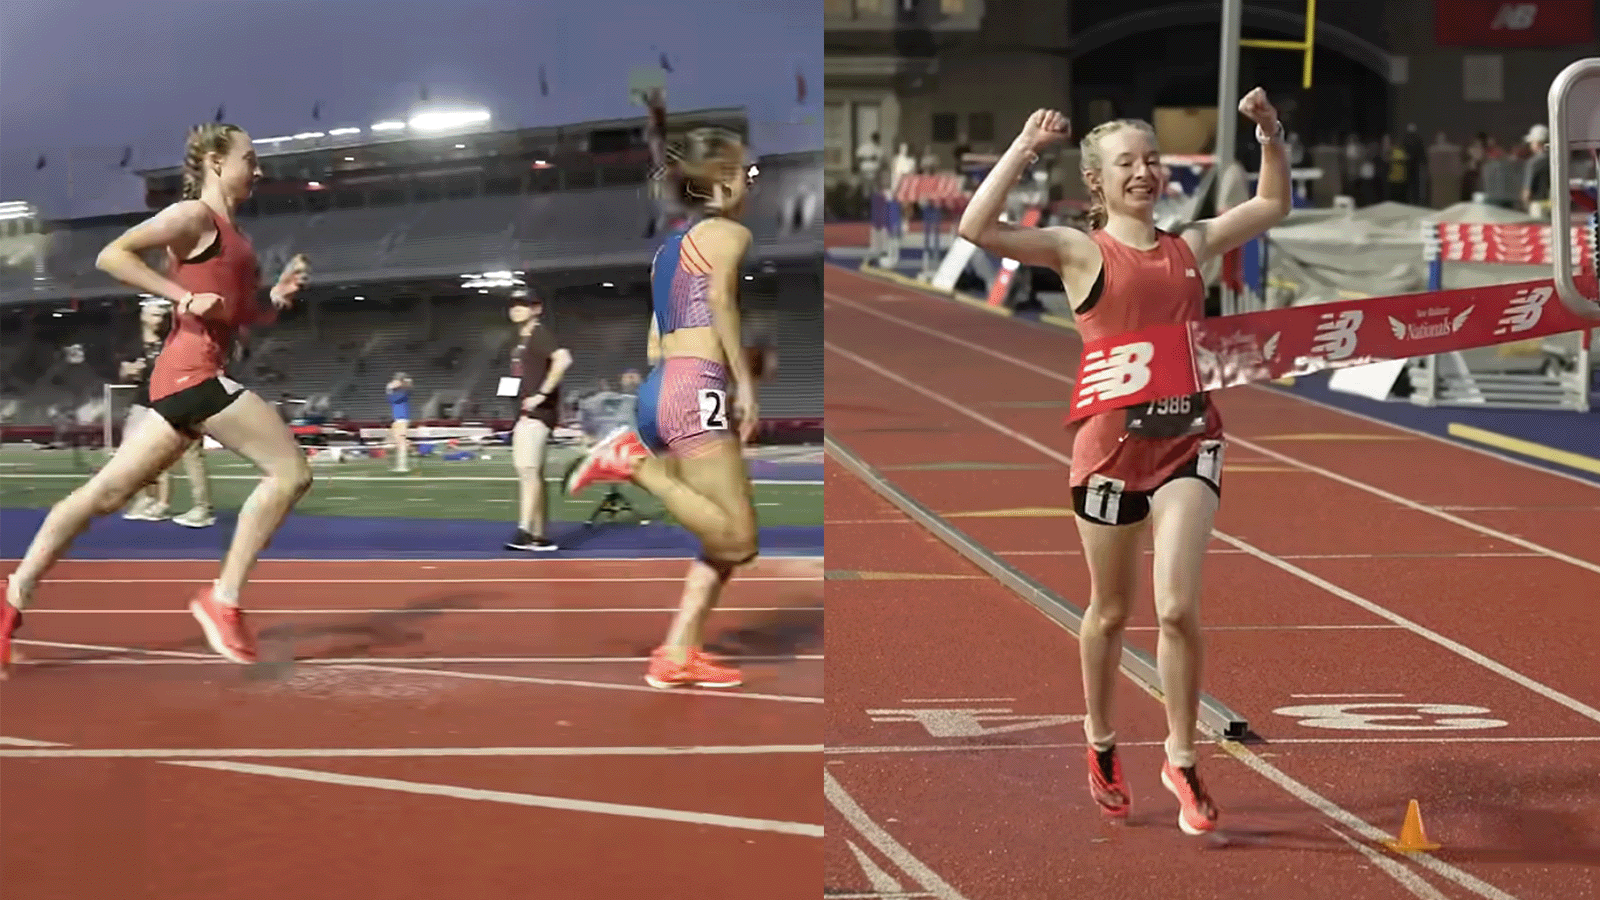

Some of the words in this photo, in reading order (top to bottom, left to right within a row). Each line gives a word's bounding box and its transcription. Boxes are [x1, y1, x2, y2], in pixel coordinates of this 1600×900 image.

[1310, 310, 1363, 360] NB
[1406, 317, 1452, 341] Nationals
[1493, 286, 1553, 335] NB
[1076, 342, 1154, 409] NB
[706, 391, 723, 427] 2
